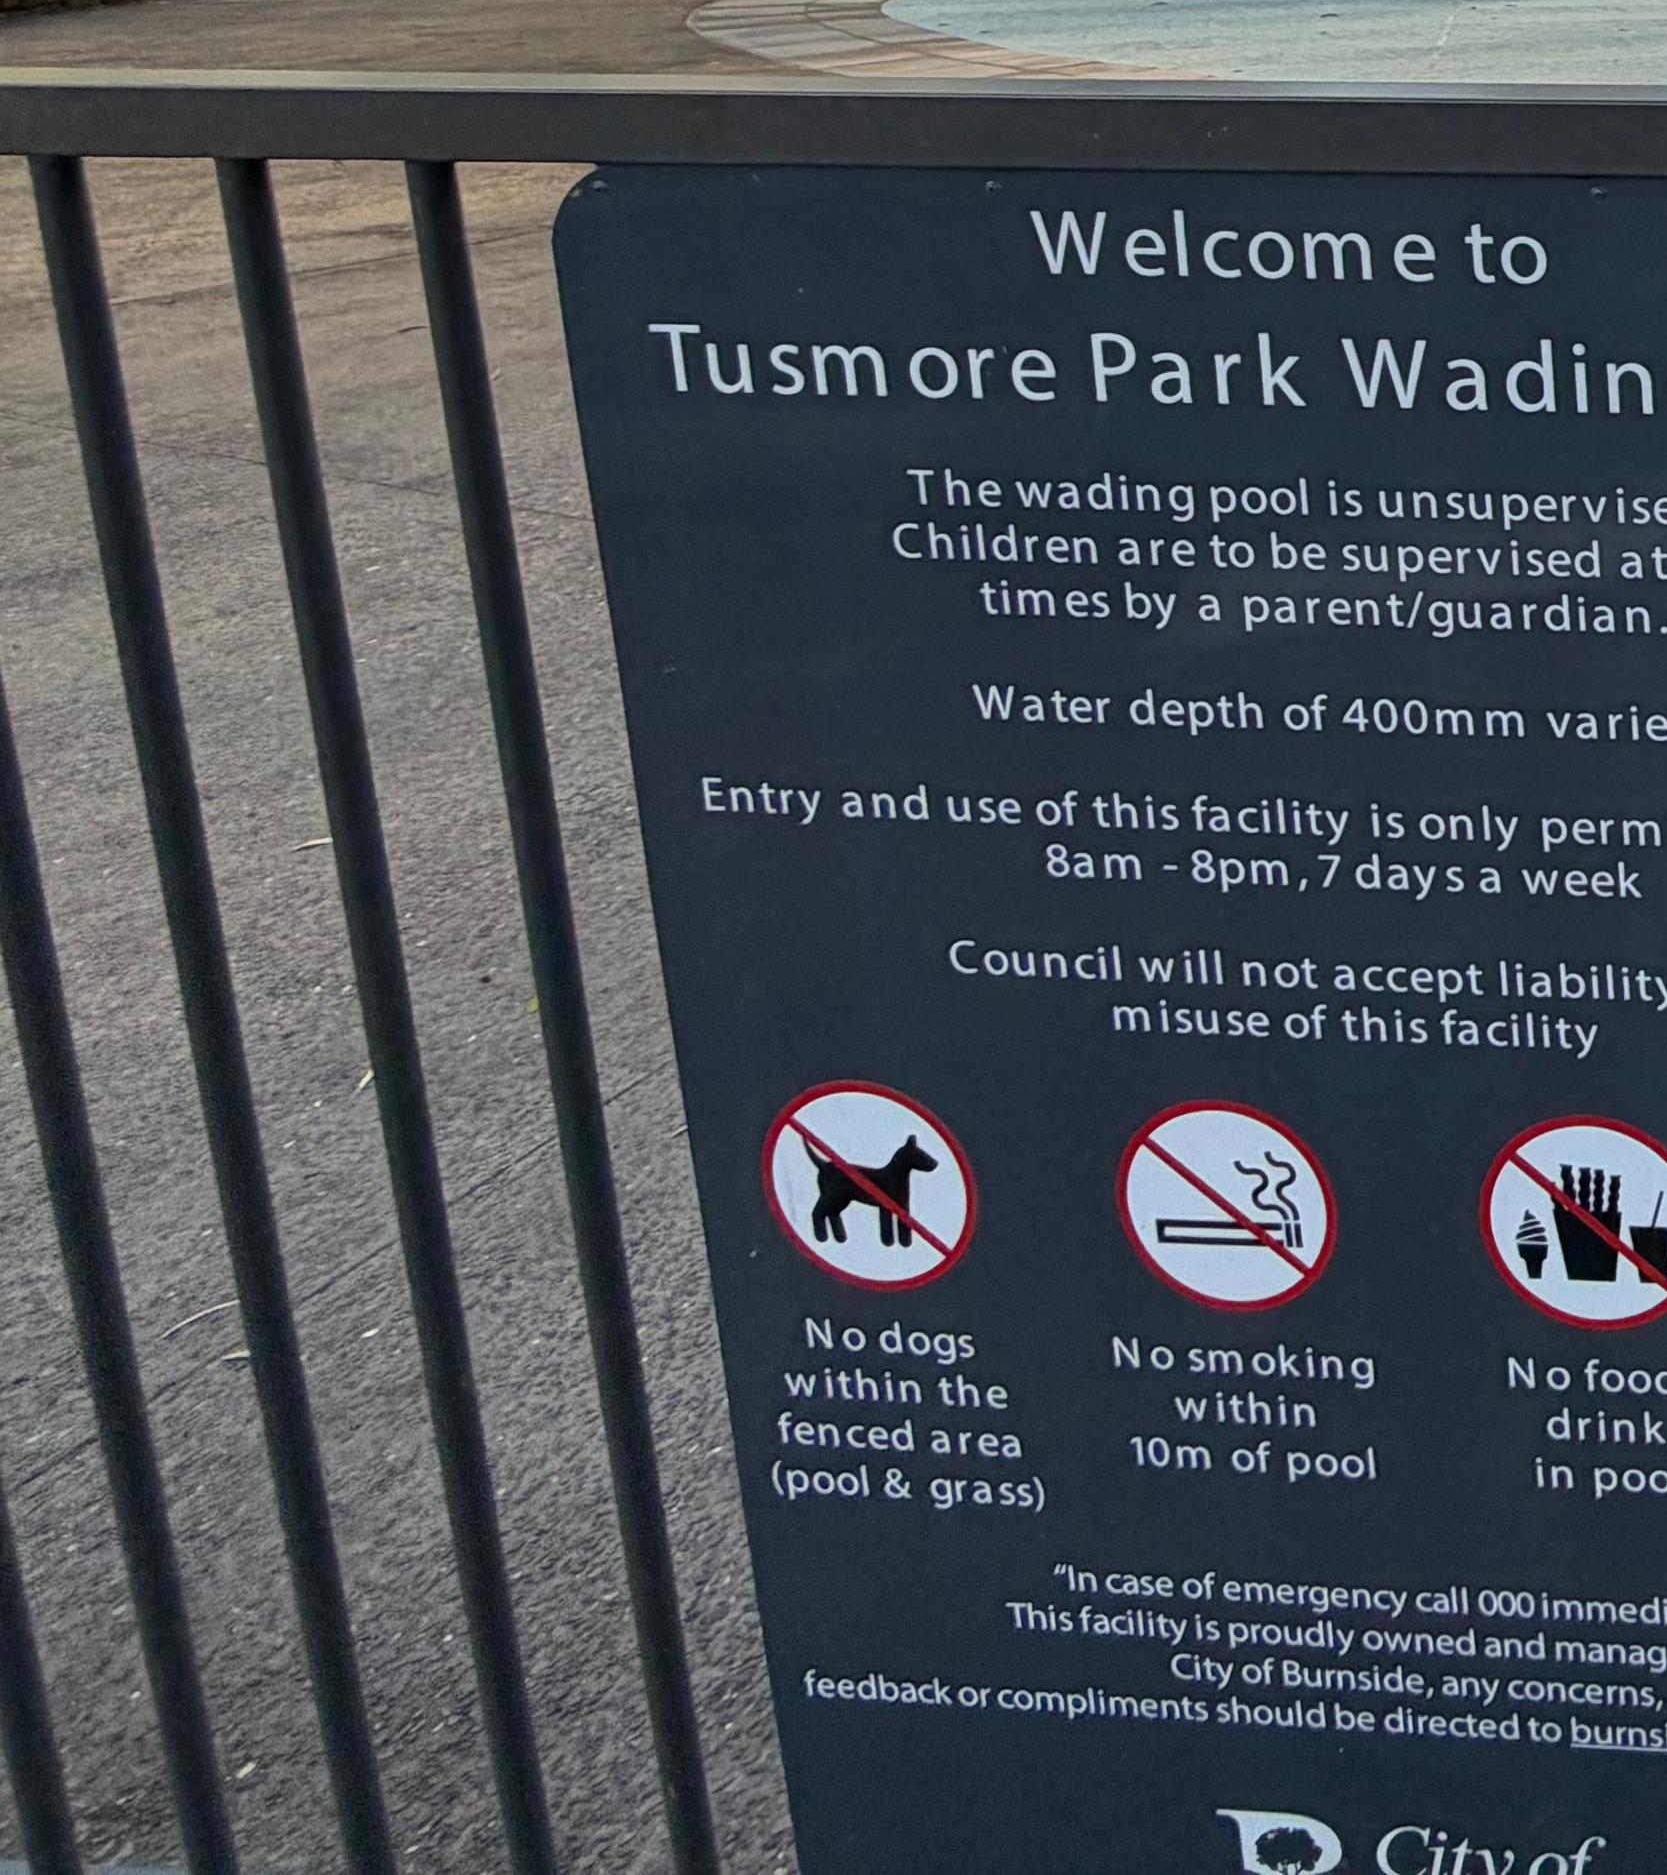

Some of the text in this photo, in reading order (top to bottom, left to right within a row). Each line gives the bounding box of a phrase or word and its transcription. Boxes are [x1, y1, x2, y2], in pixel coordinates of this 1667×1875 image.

[1030, 210, 1547, 284] Welcome to
[648, 324, 1056, 401] Tusmore
[1091, 333, 1306, 406] Park
[906, 469, 1001, 507] The
[1015, 473, 1194, 522] wading
[1210, 478, 1309, 522] pool
[1328, 480, 1362, 516] is
[893, 522, 1098, 564] Children
[1118, 538, 1195, 566] are
[1209, 535, 1254, 568] to
[1270, 532, 1326, 570] be
[1342, 540, 1600, 582] supervised
[980, 580, 1667, 637] times by a parent/guardian.
[972, 684, 1110, 723] Water
[1130, 689, 1263, 736] depth
[1284, 694, 1327, 730] of
[1342, 699, 1524, 737] 400mm
[702, 777, 820, 825] Entry
[842, 785, 929, 820] and
[947, 796, 1021, 824] use
[1036, 790, 1078, 826] of
[1092, 792, 1179, 830] this
[1191, 795, 1348, 845] facility
[1371, 803, 1405, 838] is
[1419, 805, 1518, 851] only
[1046, 844, 1142, 880] 8am
[1355, 853, 1464, 900] days
[1479, 867, 1501, 893] a
[1522, 861, 1642, 898] week
[949, 940, 1122, 980] Council
[1139, 949, 1223, 985] will
[1242, 958, 1318, 989] not
[1334, 964, 1484, 1003] accept
[1113, 1000, 1598, 1059] misuse of this facility
[805, 1318, 975, 1365] No dogs
[1113, 1336, 1374, 1389] No smoking
[784, 1368, 1008, 1409] within the
[1508, 1357, 1571, 1390] No
[777, 1412, 1021, 1458] fenced area
[1175, 1391, 1316, 1427] within
[1547, 1407, 1666, 1444] drink
[772, 1460, 1045, 1512] (pool & grass)
[1130, 1437, 1376, 1483] 10m of pool
[1536, 1457, 1573, 1489] in
[1105, 1574, 1173, 1597] case
[1182, 1572, 1215, 1600] of
[1223, 1581, 1407, 1618] emergency
[1416, 1586, 1469, 1615] call
[1478, 1590, 1535, 1618] 000
[1005, 1602, 1073, 1632] This
[1079, 1605, 1187, 1646] facility
[1195, 1614, 1220, 1641] is
[1228, 1620, 1354, 1656] proudly
[1362, 1628, 1476, 1656] owned
[1485, 1632, 1546, 1660] and
[804, 1669, 952, 1705] feedback
[957, 1687, 991, 1708] or
[997, 1688, 1208, 1722] compliments
[1216, 1696, 1326, 1729] should
[1334, 1703, 1375, 1732] be
[1384, 1706, 1520, 1740] directed
[1527, 1717, 1562, 1743] to
[1171, 1653, 1663, 1712] City of Burnside, any concerns,
[1376, 1826, 1515, 1875] City
[1529, 1836, 1606, 1875] of
